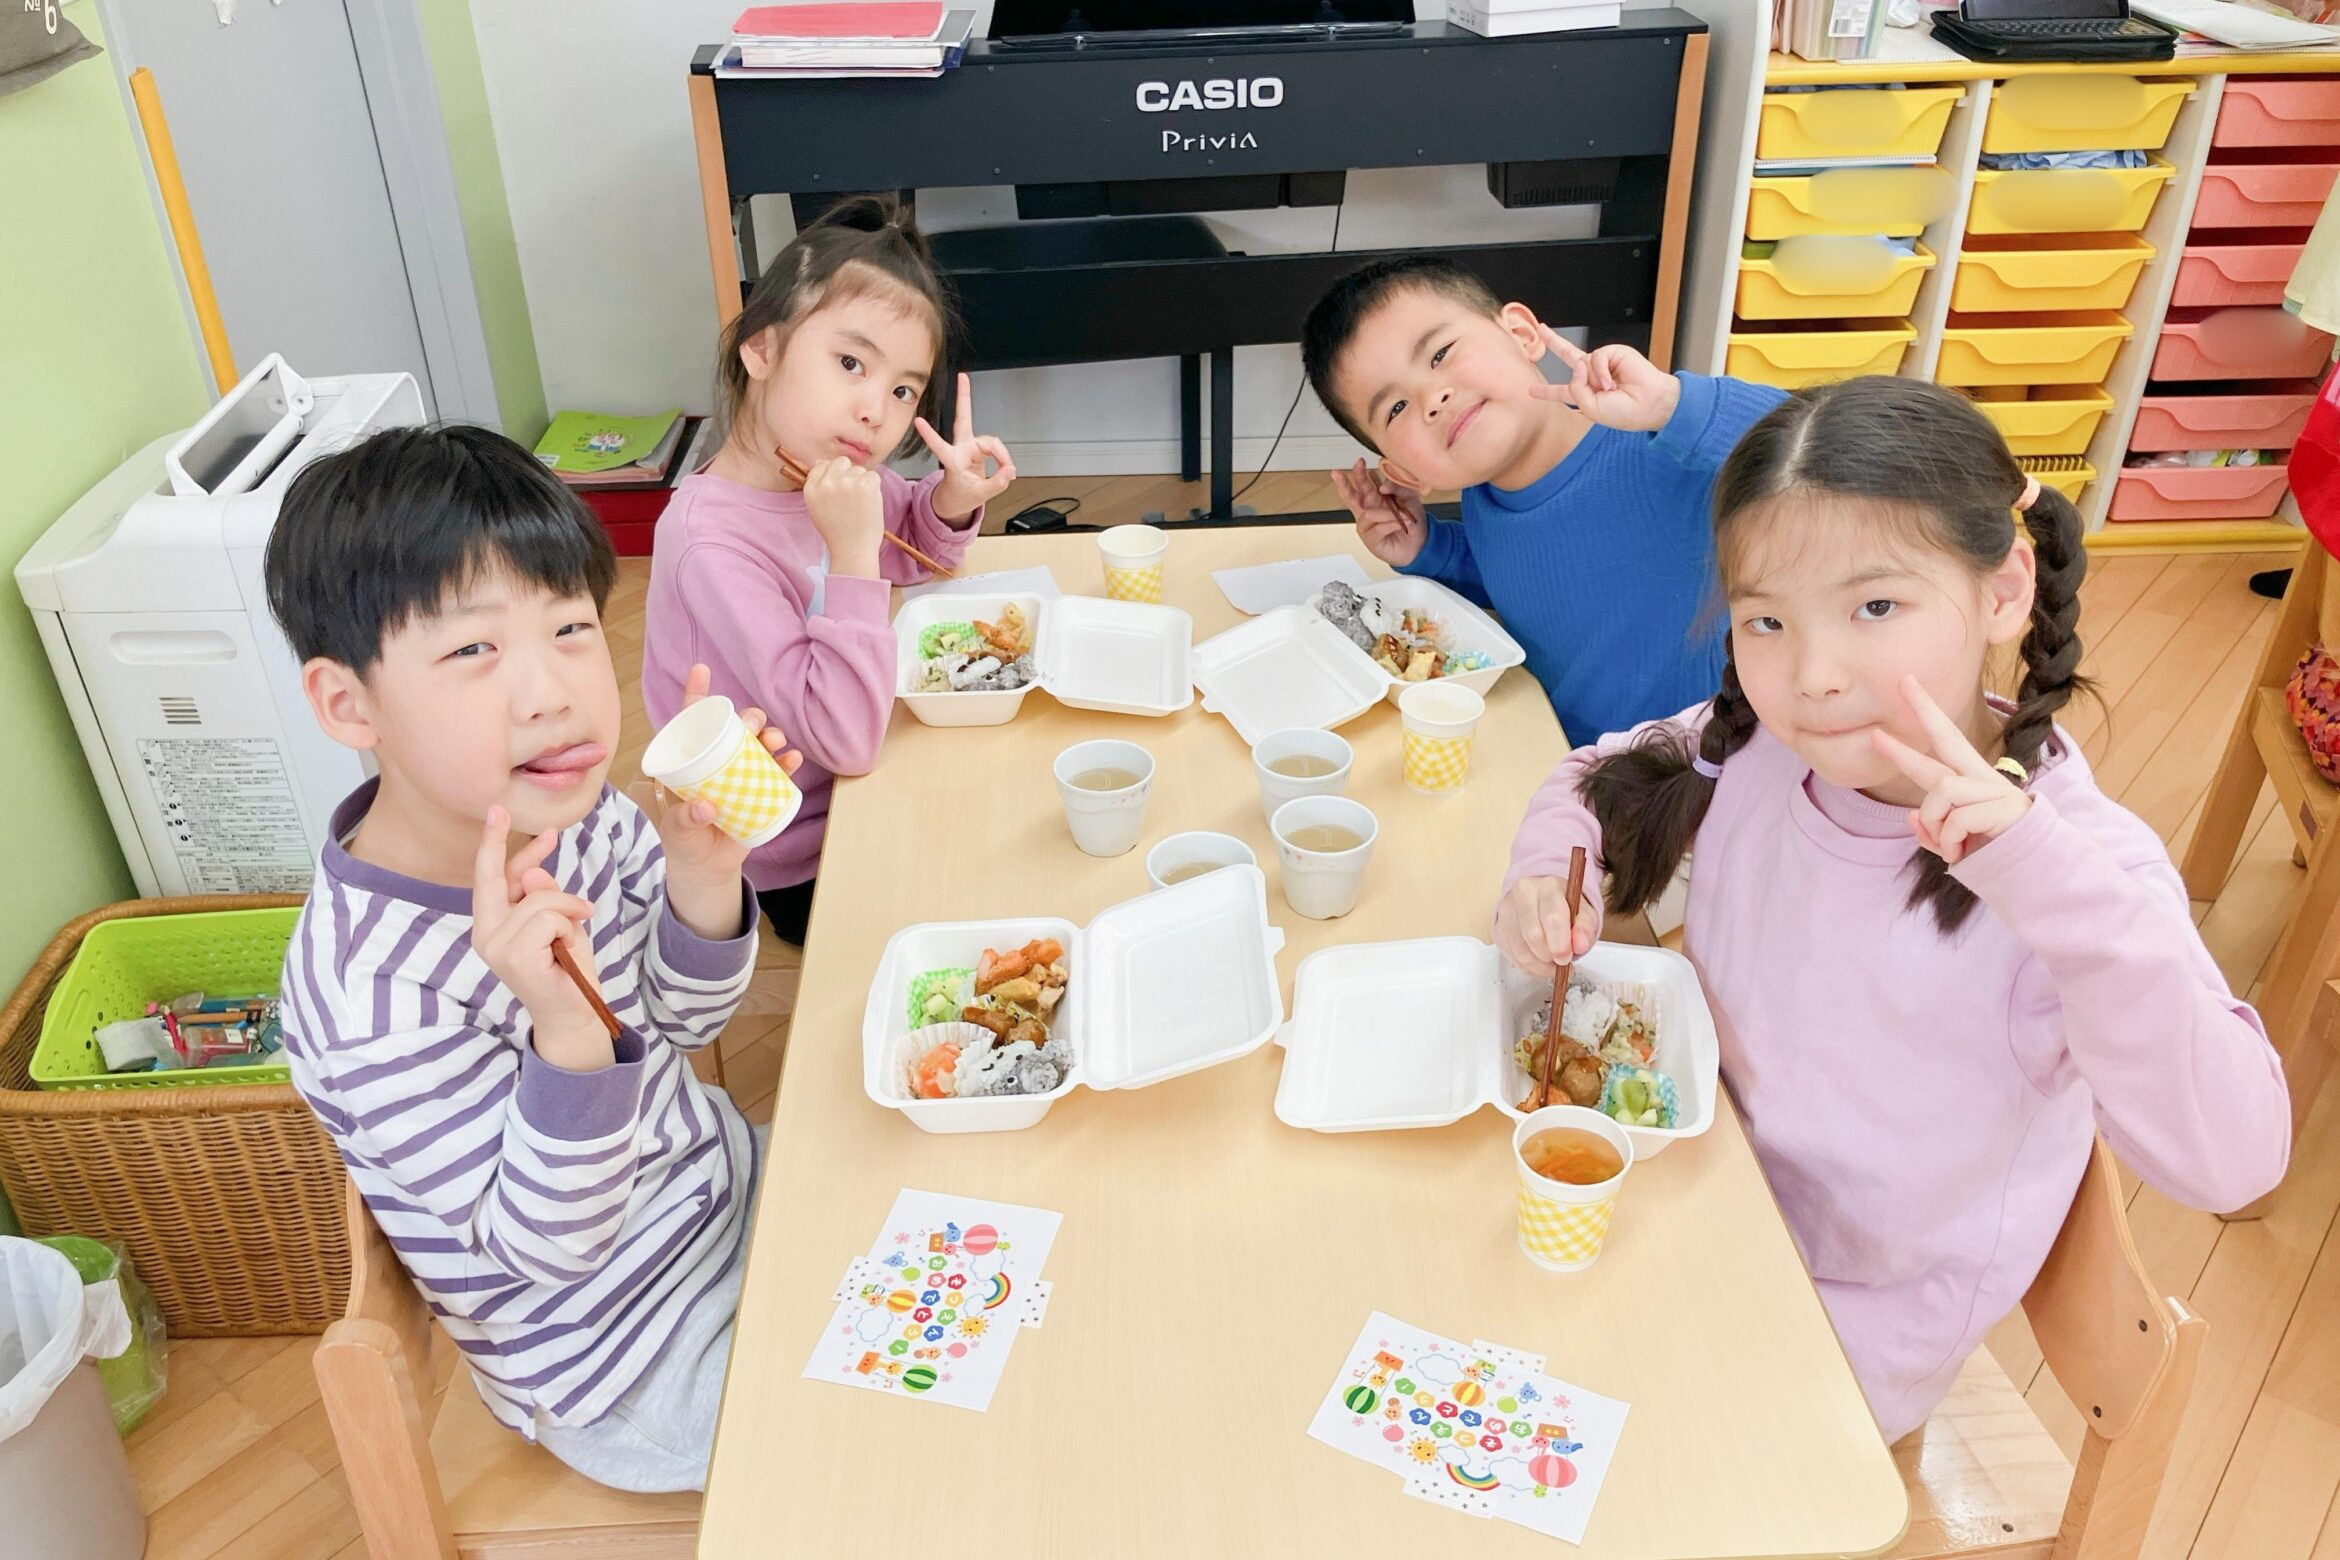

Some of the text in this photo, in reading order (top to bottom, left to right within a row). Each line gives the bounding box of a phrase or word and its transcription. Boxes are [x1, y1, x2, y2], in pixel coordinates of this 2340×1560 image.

[1135, 77, 1284, 112] CASIO
[1414, 1410, 1498, 1449] そつえん
